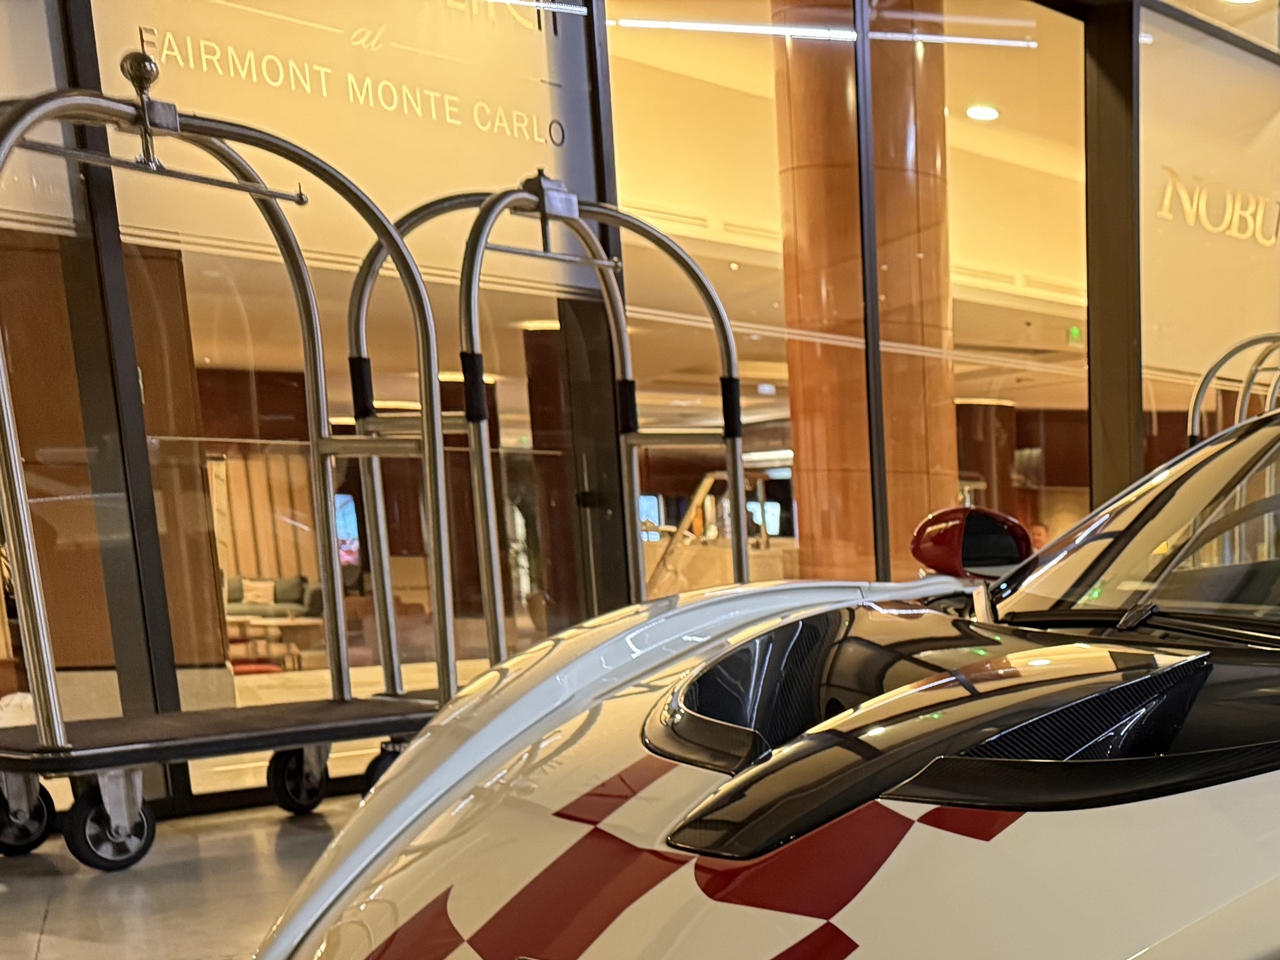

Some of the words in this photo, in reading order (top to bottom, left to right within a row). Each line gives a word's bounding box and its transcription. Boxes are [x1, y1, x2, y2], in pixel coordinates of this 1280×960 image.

[138, 25, 332, 98] FAIRMONT
[346, 72, 462, 126] MONTE
[473, 100, 566, 147] CARLO
